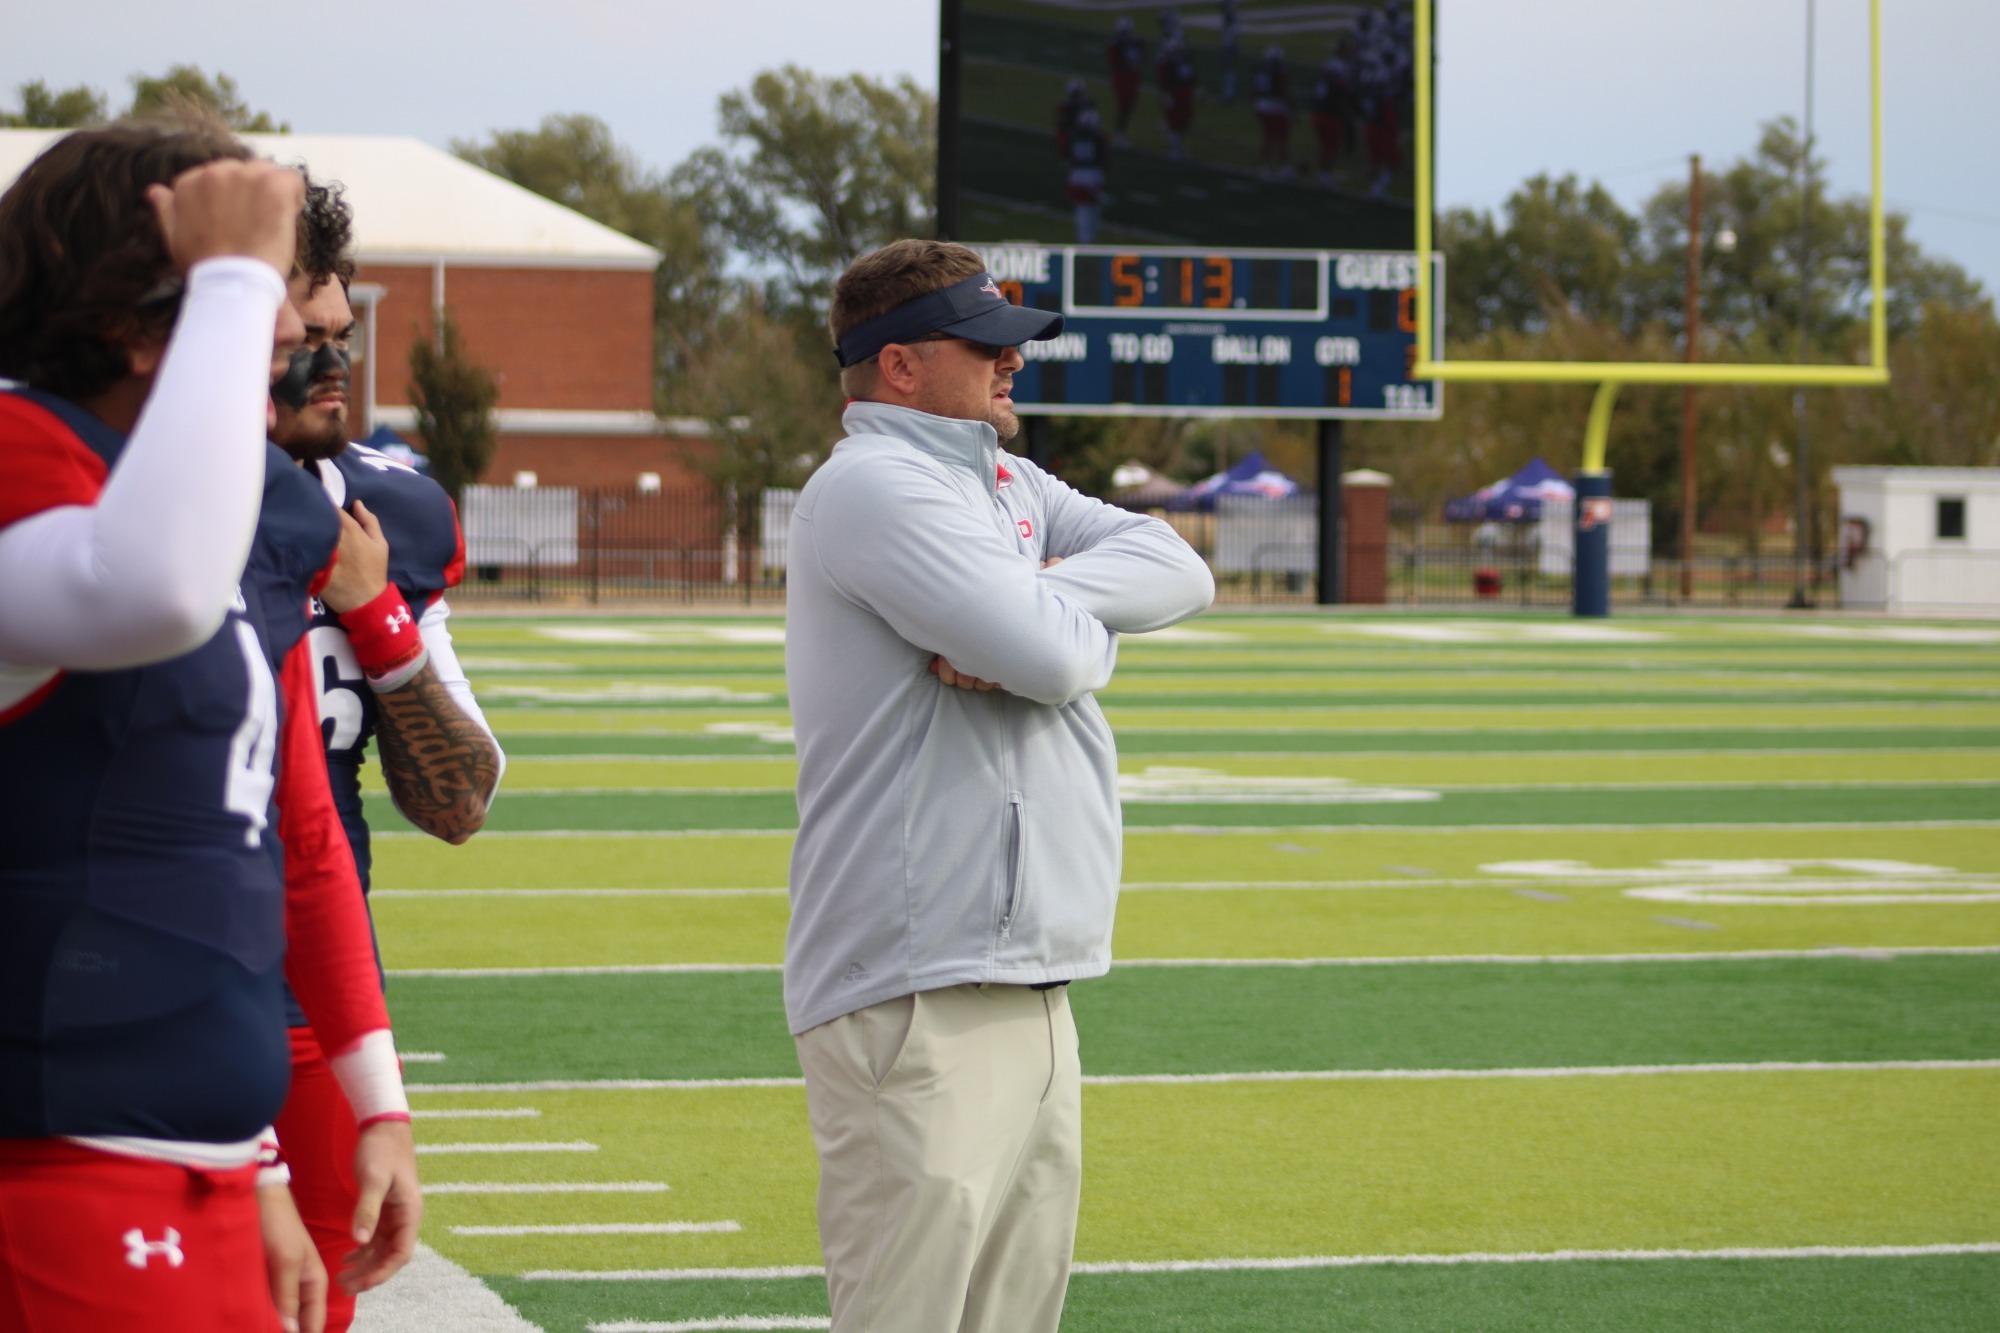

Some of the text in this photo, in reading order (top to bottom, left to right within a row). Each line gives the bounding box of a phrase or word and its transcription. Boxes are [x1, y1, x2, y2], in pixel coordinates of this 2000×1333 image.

[1108, 332, 1174, 364] TO GO
[1212, 334, 1292, 365] BALL ON
[1315, 335, 1361, 366] QTR
